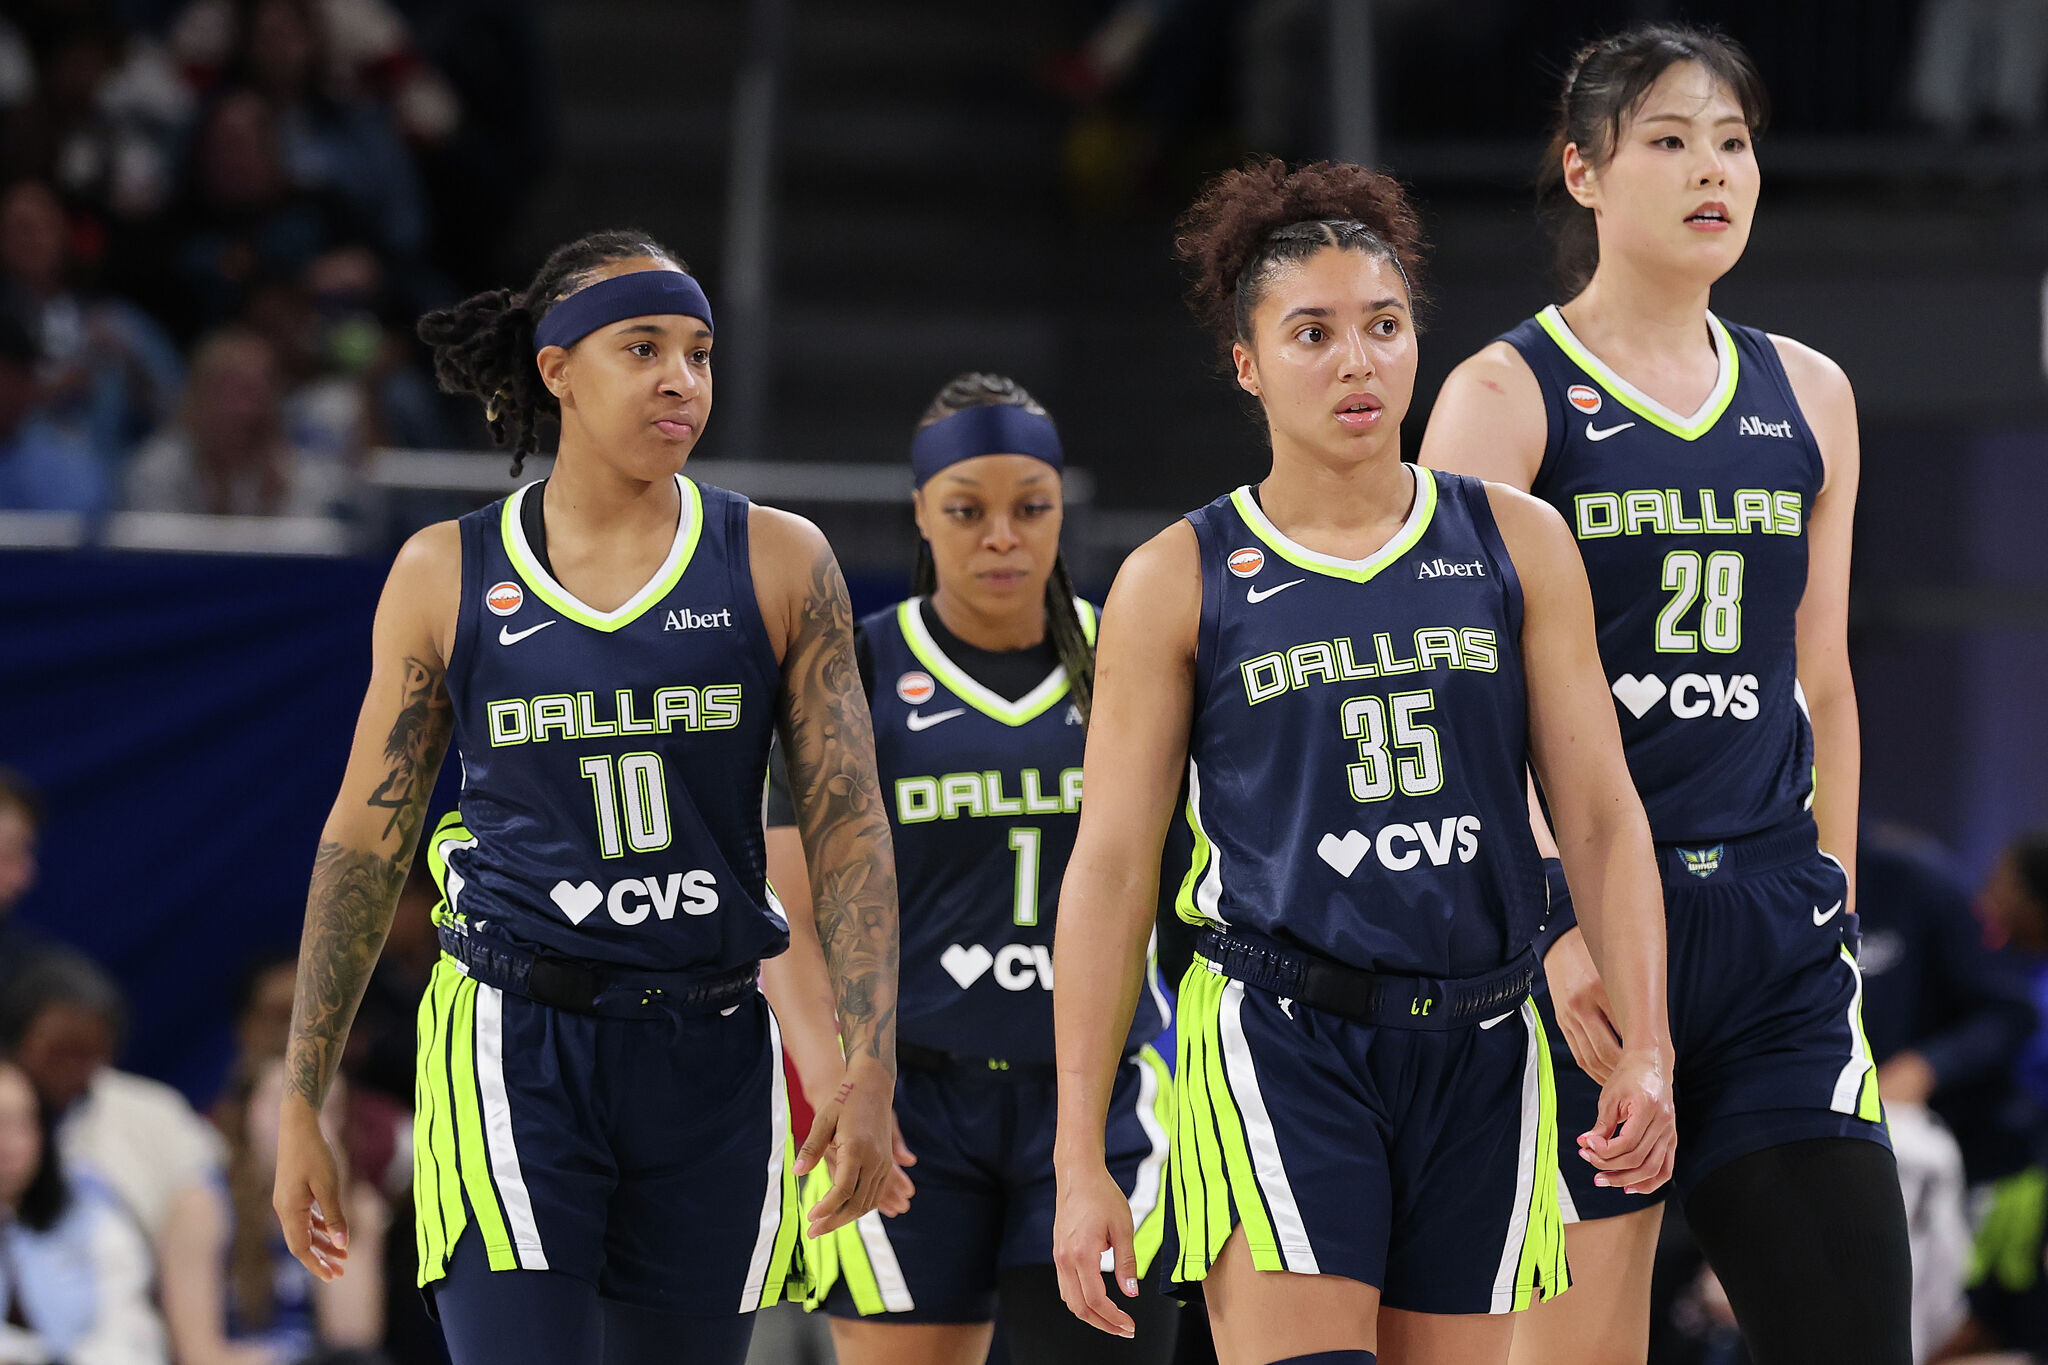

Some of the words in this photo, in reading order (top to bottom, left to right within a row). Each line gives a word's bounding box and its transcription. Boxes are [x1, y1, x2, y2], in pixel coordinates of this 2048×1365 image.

[1739, 416, 1793, 438] Albert
[1574, 489, 1802, 539] DALLAS
[1418, 559, 1485, 580] Albert
[664, 608, 732, 632] Albert
[1655, 550, 1744, 654] 28
[1240, 627, 1498, 706] DALLAS
[487, 684, 742, 747] DALLAS
[1670, 673, 1759, 720] CVS
[1340, 689, 1444, 803] 35
[580, 751, 671, 860] 10
[895, 768, 1087, 824] DALLA
[1375, 816, 1481, 872] CVS
[607, 869, 719, 926] CVS
[1008, 827, 1042, 927] 1
[993, 943, 1054, 992] CV
